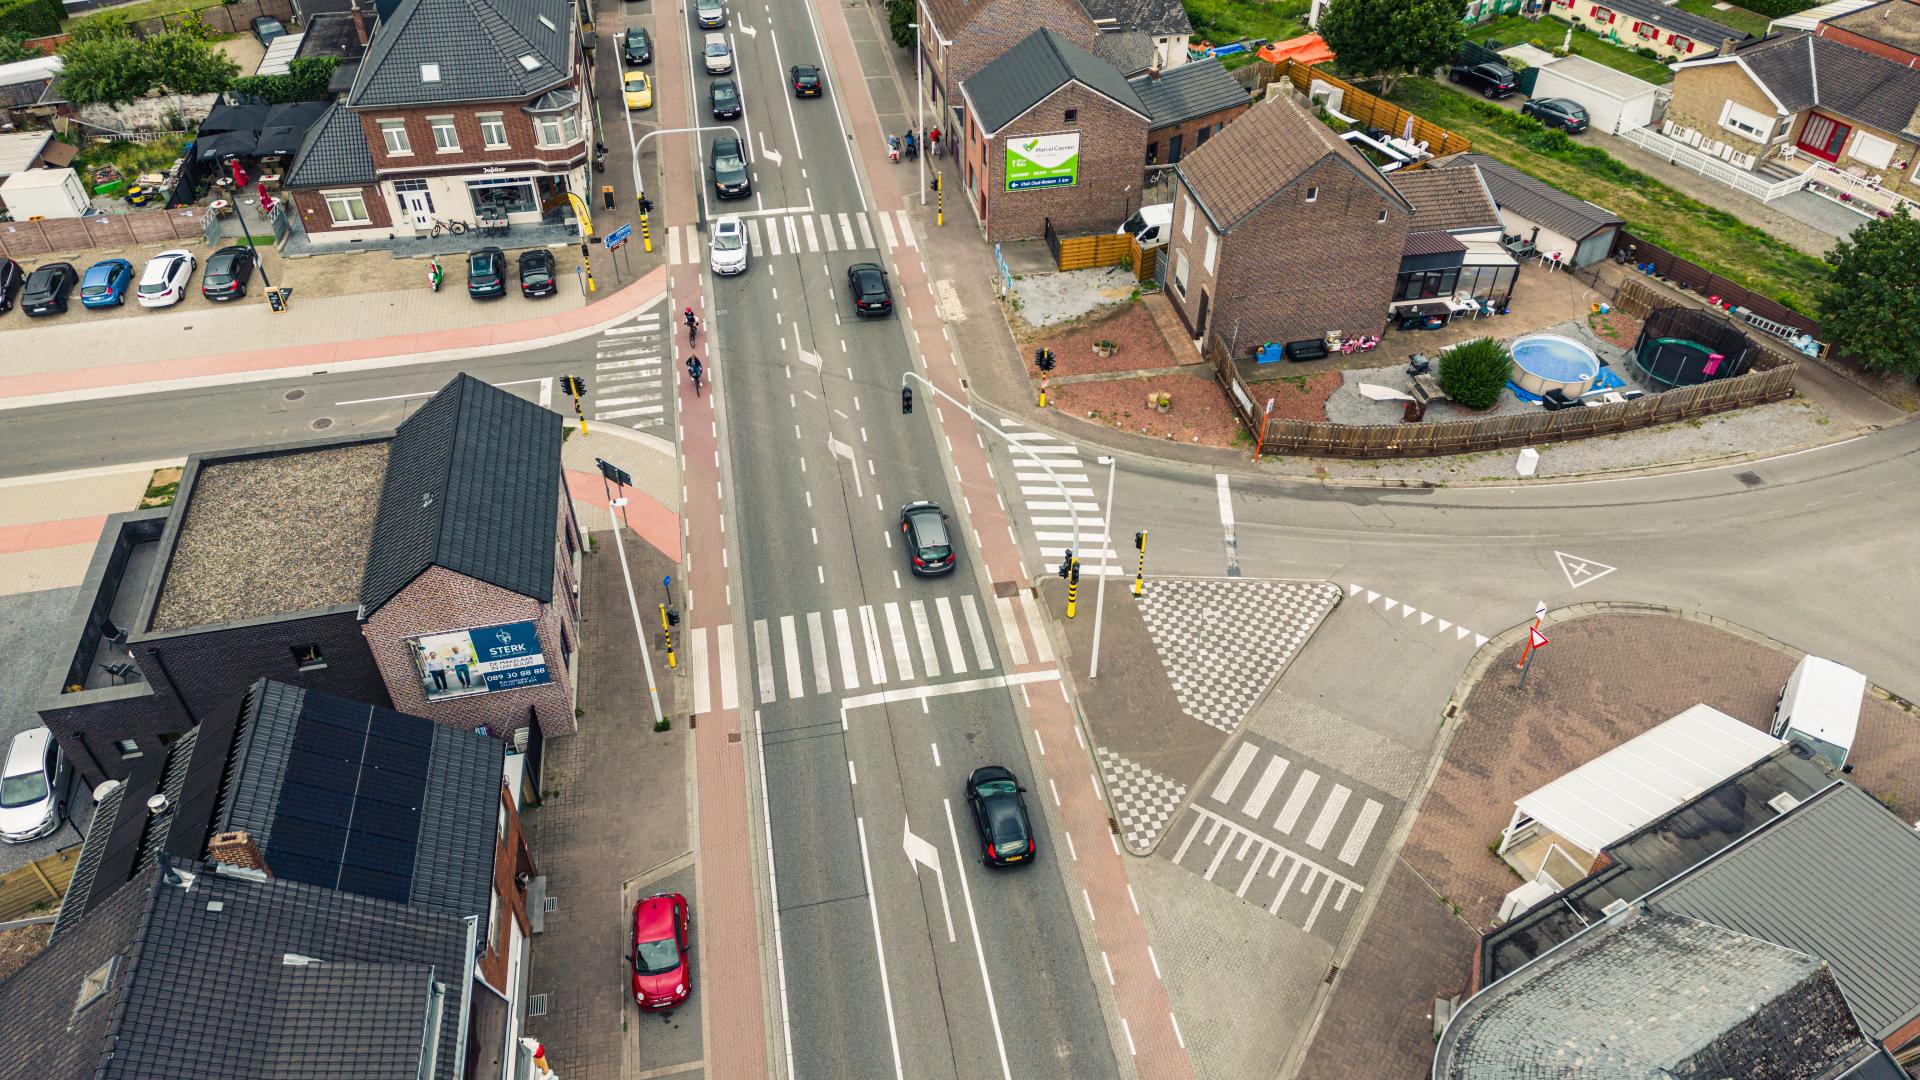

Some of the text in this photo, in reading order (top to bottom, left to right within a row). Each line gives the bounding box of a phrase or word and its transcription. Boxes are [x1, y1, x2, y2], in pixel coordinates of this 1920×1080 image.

[489, 643, 527, 655] STERK
[487, 674, 504, 682] 089
[519, 669, 532, 677] 88
[533, 667, 545, 675] 88
